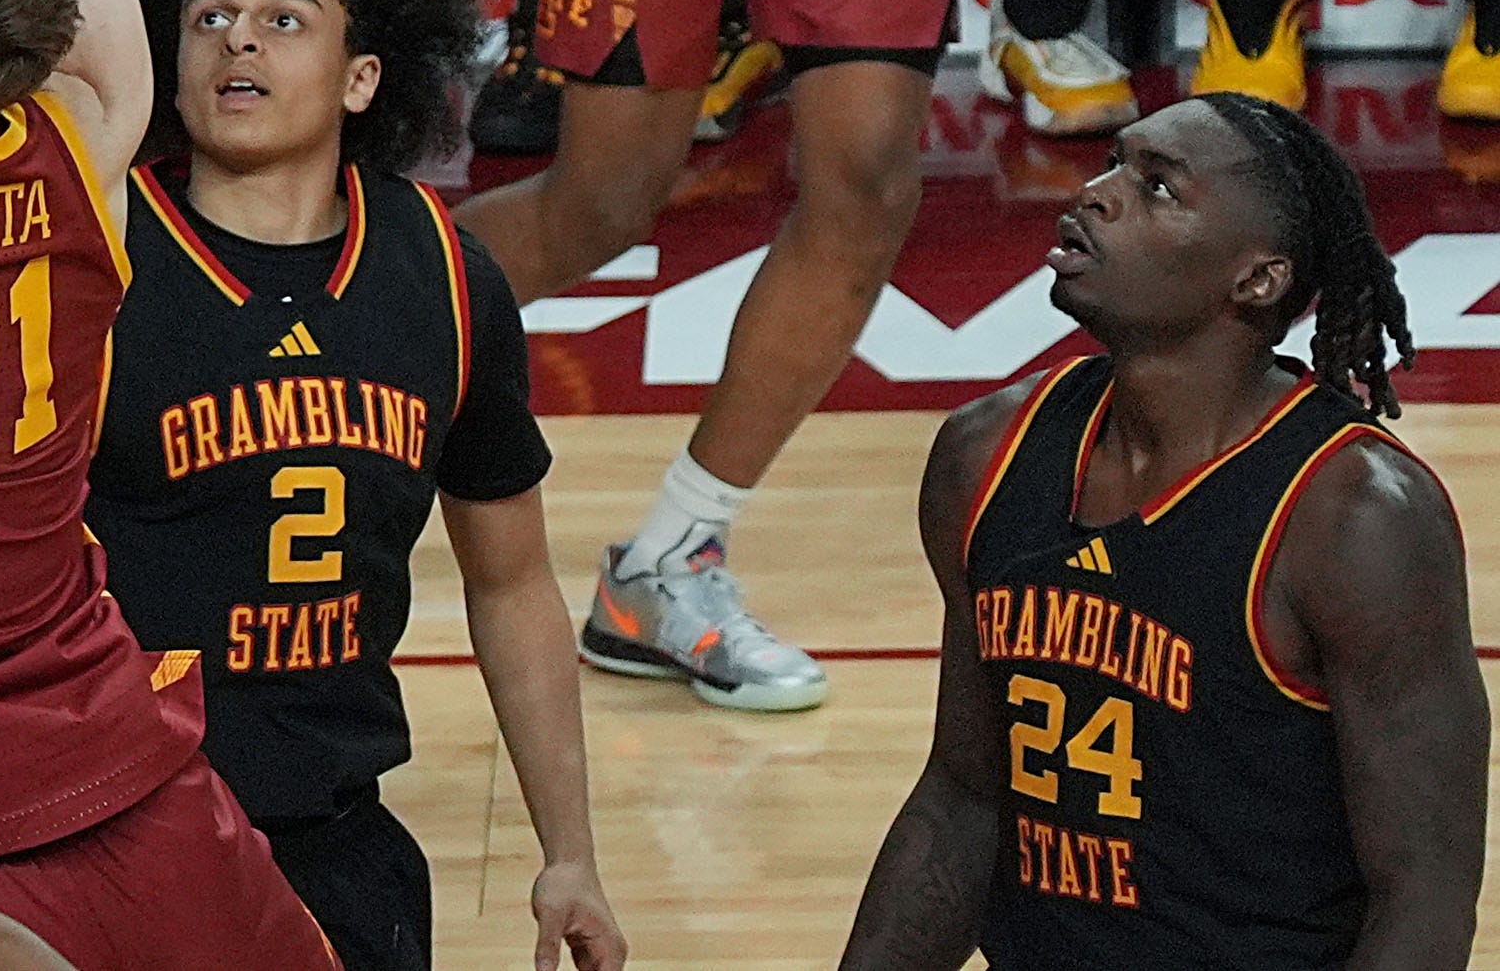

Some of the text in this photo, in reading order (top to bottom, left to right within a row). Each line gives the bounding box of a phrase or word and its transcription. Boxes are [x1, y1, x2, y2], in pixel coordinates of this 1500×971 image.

[159, 375, 428, 480] GRAMBLING
[268, 466, 346, 584] 2
[227, 591, 362, 673] STATE
[975, 585, 1194, 713] GRAMBLING
[1007, 673, 1143, 820] 24
[1018, 814, 1139, 909] STATE
